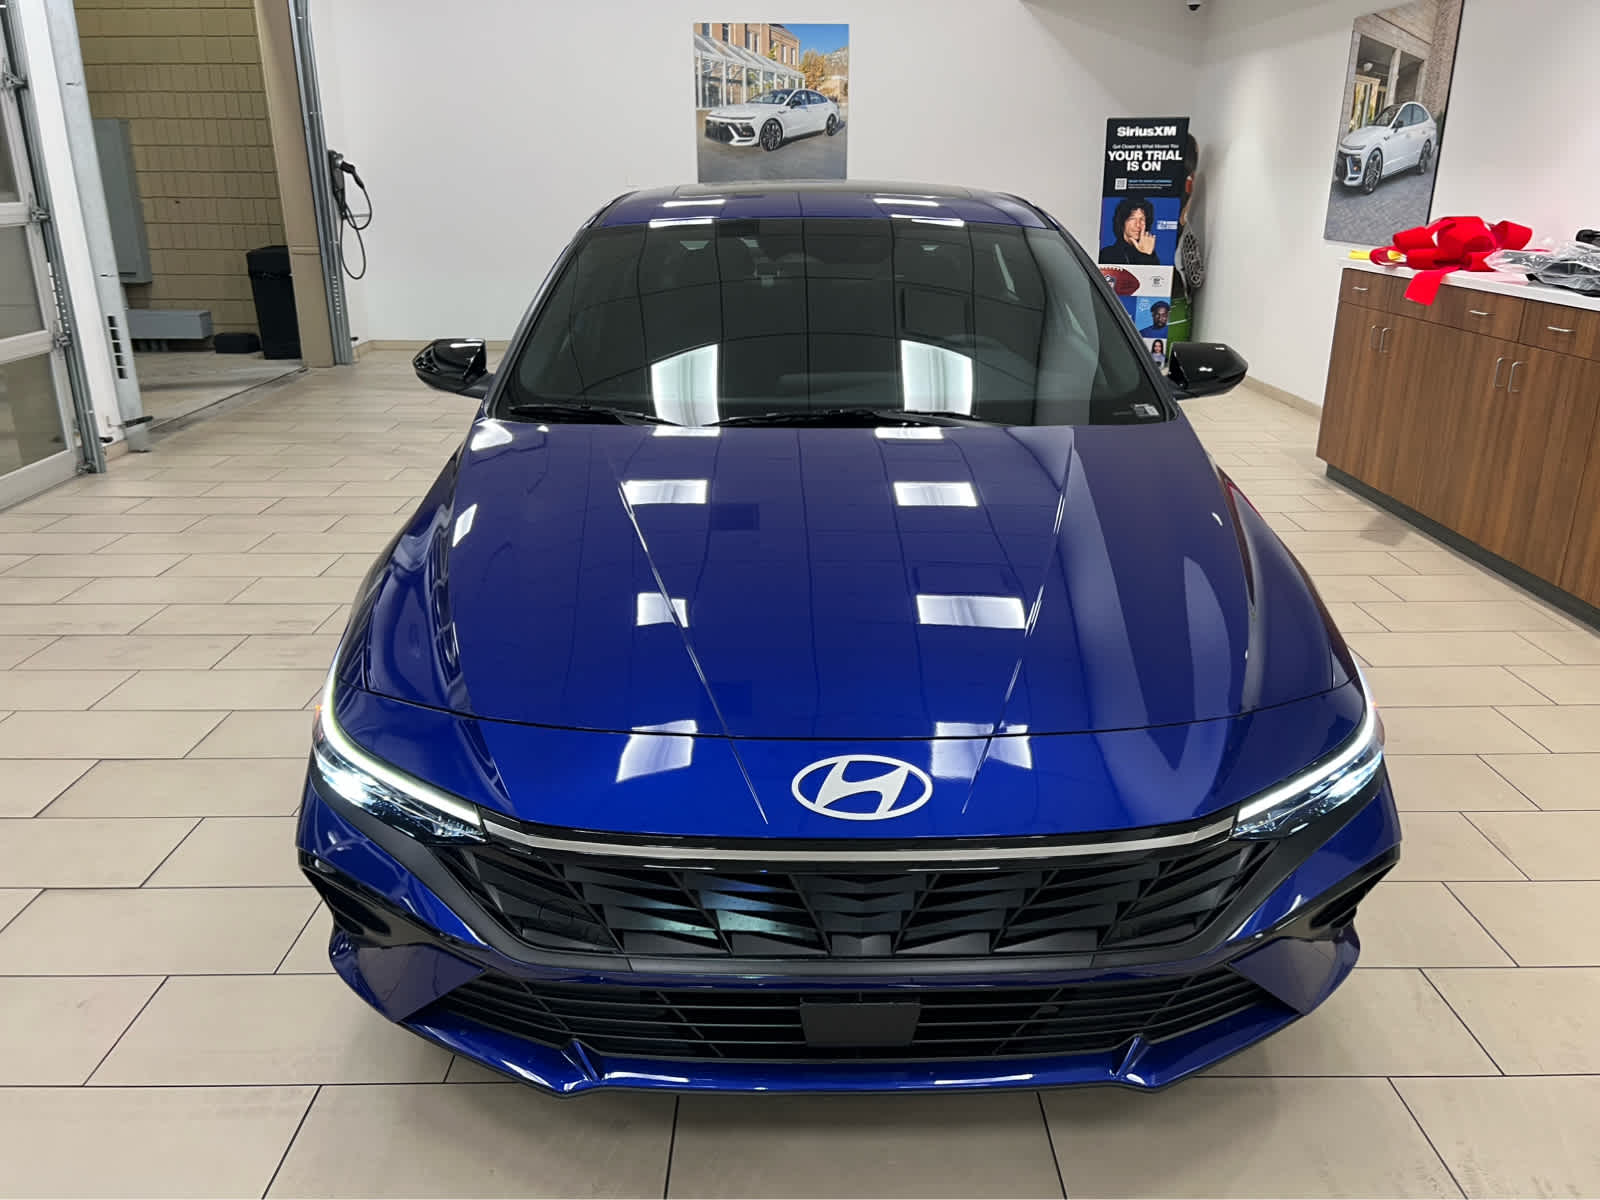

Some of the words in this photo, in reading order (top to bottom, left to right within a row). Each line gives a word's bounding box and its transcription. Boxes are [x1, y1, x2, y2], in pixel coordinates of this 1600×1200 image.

[1117, 126, 1176, 137] SiriusXM
[1108, 151, 1142, 160] YOUR
[1146, 151, 1182, 160] TRIAL
[1127, 161, 1139, 171] IS
[1141, 161, 1161, 171] ON
